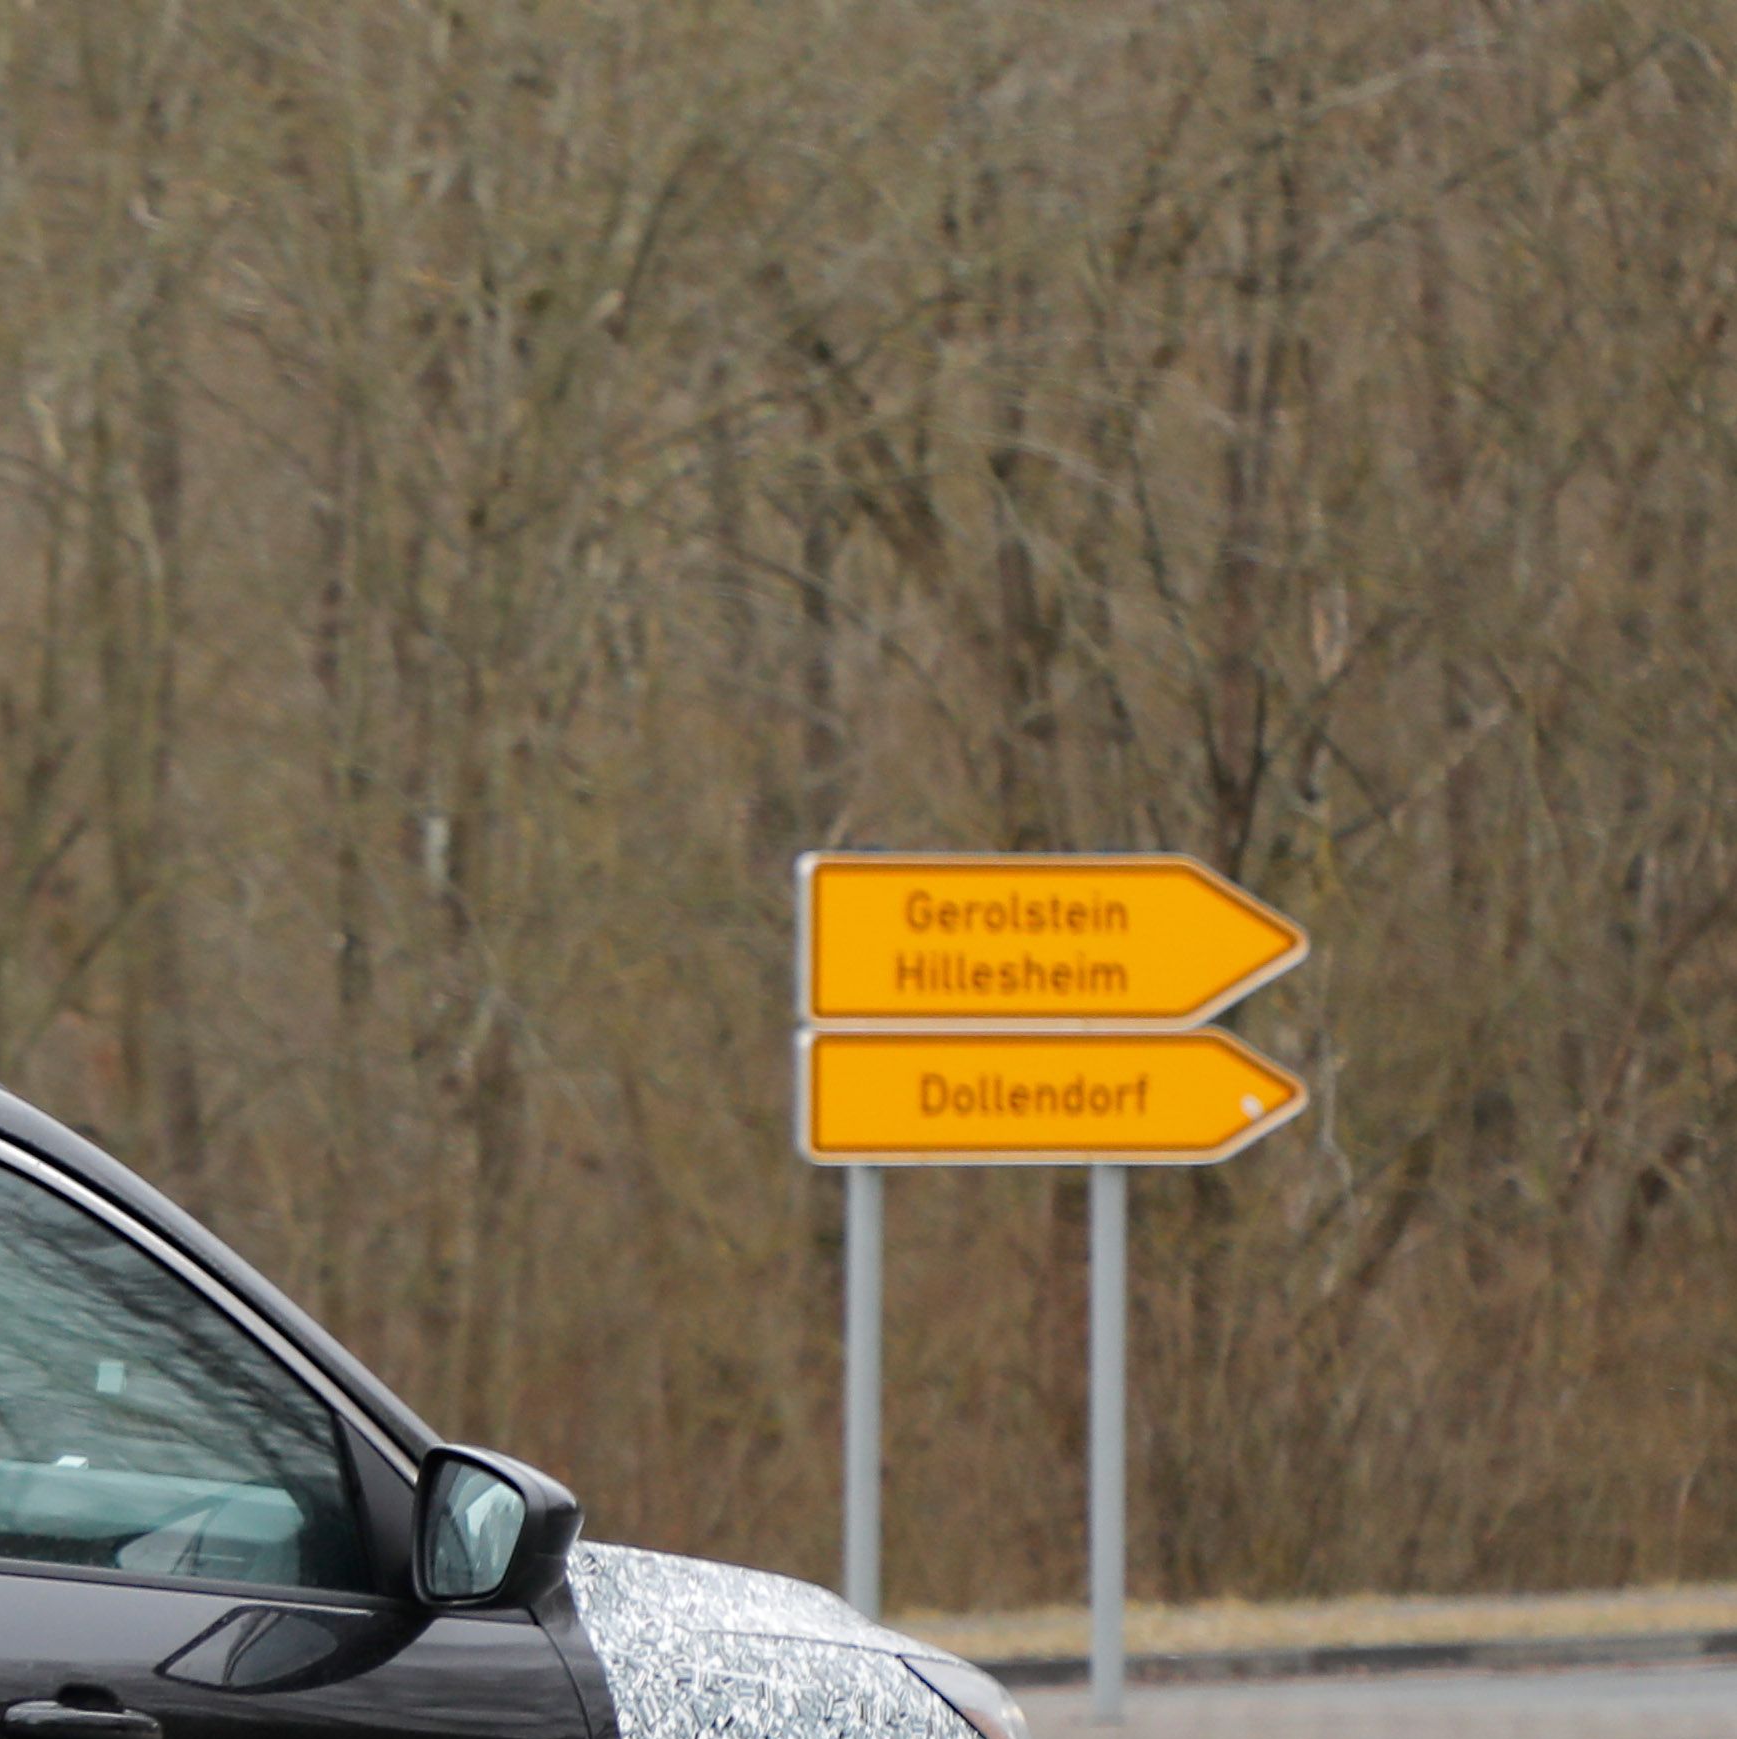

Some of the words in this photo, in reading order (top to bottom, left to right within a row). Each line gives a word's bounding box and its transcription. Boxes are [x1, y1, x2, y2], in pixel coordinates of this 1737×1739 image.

[904, 890, 1129, 932] Gerolstein
[896, 951, 1128, 994] Hillesheim
[921, 1073, 1150, 1116] Dollendorf
